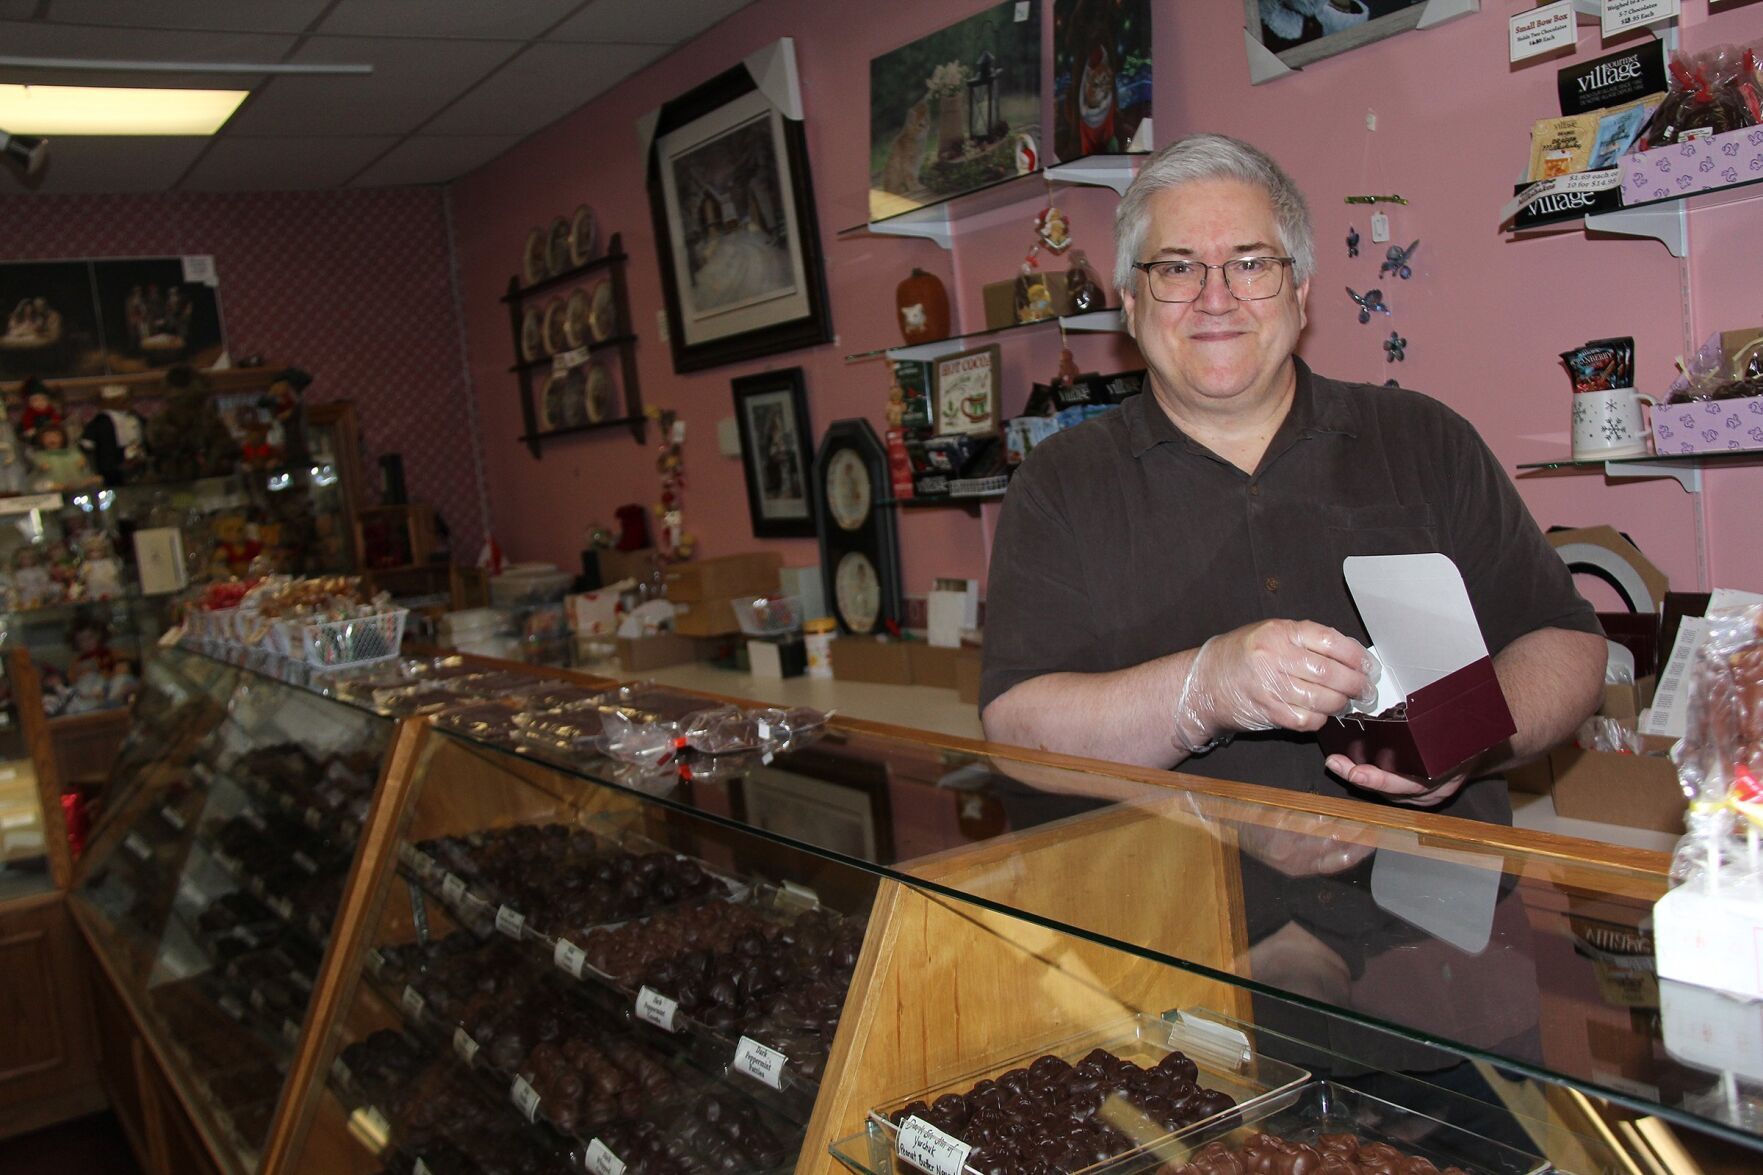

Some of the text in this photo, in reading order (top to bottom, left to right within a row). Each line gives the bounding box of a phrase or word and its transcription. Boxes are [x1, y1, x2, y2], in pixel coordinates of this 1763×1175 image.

[1515, 20, 1536, 33] Small
[1553, 14, 1569, 22] Box
[1577, 61, 1641, 92] village
[1592, 172, 1609, 180] each
[745, 1051, 771, 1071] Peppermint
[756, 1046, 767, 1057] Dark
